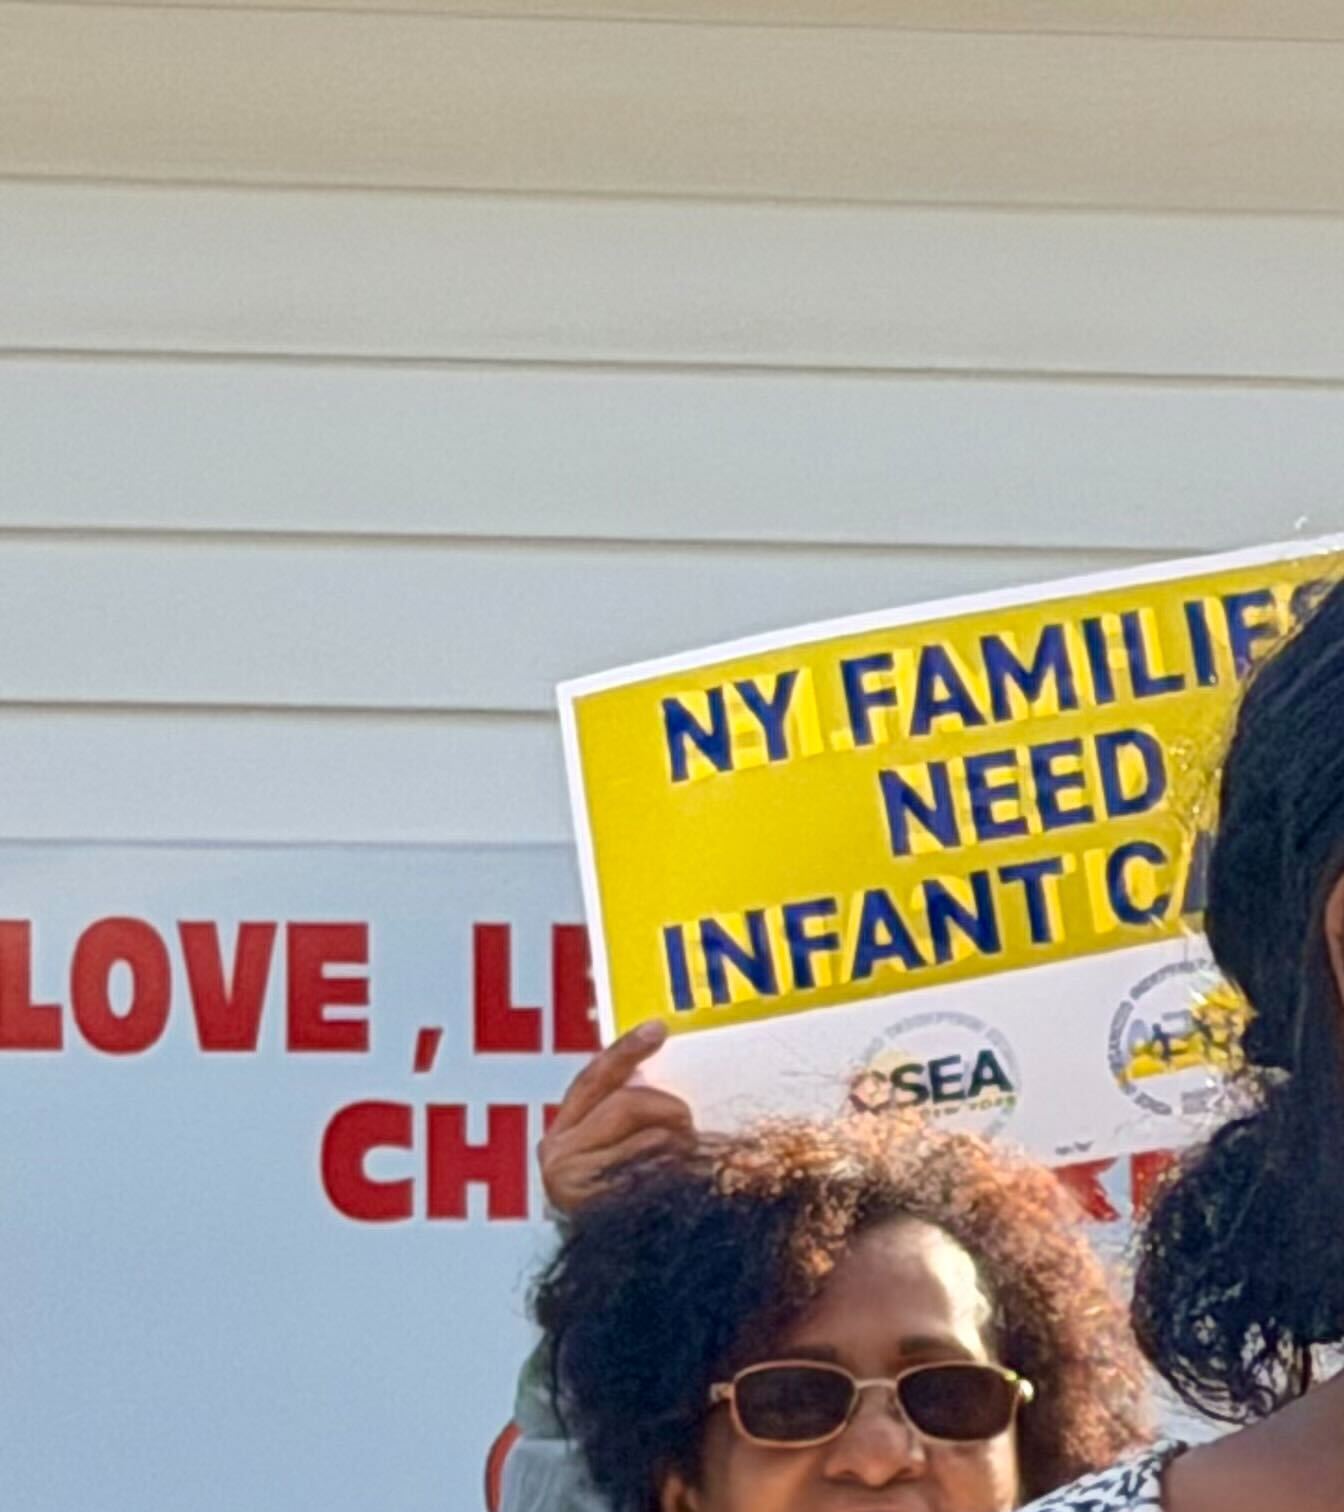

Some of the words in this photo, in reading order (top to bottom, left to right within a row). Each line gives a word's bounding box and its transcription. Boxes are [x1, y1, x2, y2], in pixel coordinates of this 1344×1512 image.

[661, 669, 799, 784] NY
[878, 728, 1168, 856] NEED
[0, 916, 370, 1055] LOVE
[472, 923, 602, 1055] LE
[663, 856, 1064, 1011] INFANT
